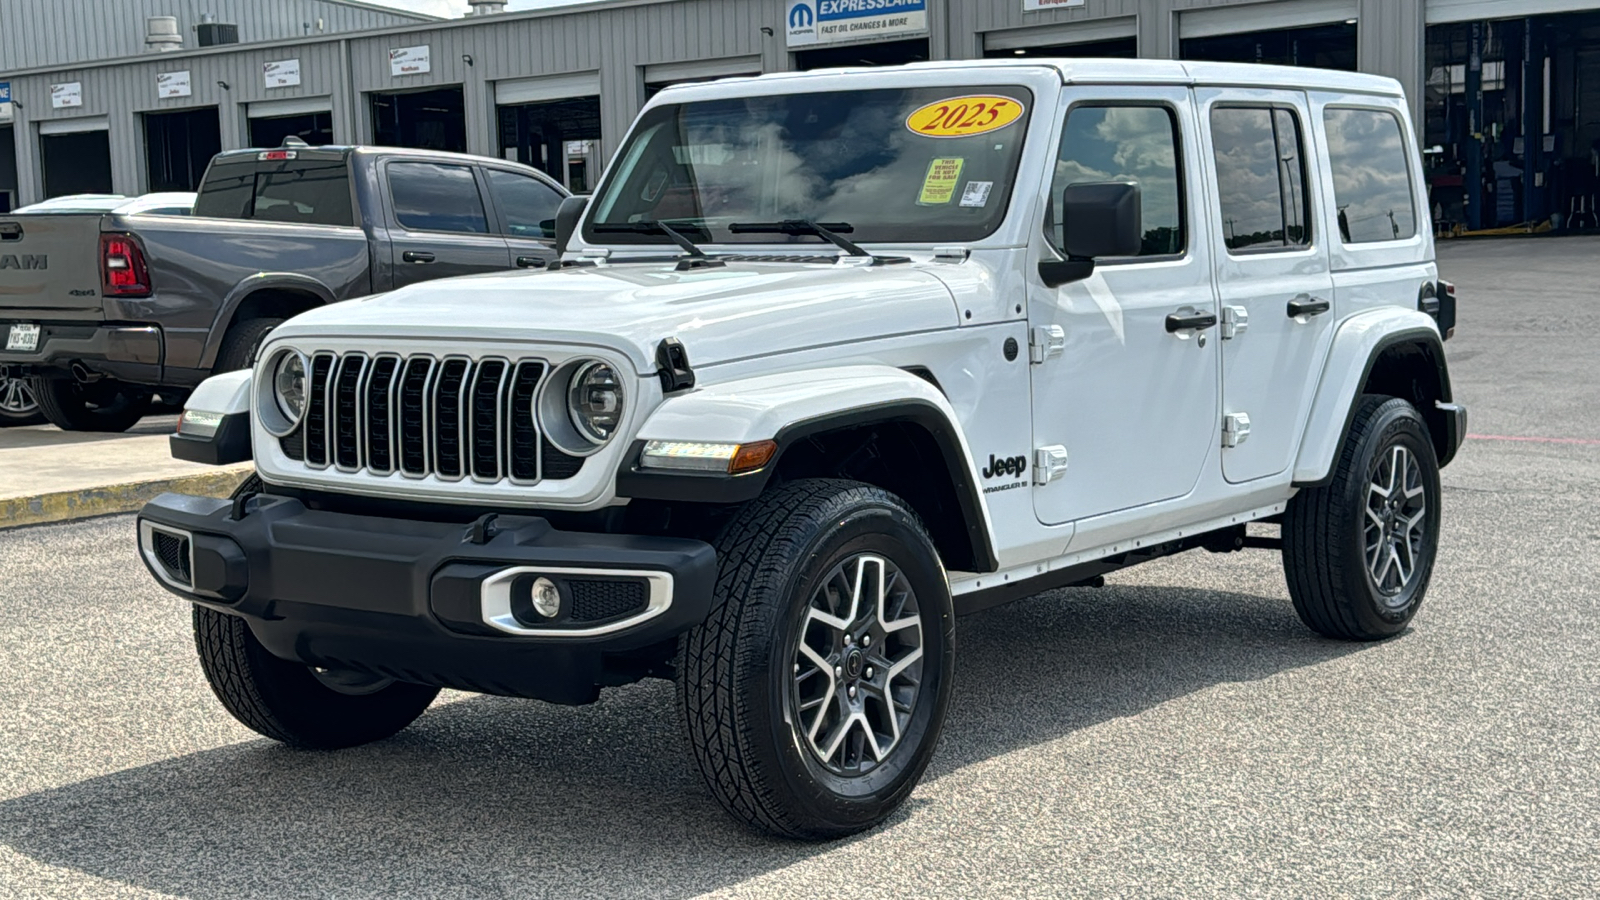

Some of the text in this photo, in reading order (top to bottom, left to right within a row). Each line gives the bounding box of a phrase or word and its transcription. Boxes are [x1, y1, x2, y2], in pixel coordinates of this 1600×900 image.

[821, 25, 838, 34] FAST
[838, 24, 849, 32] OIL
[849, 21, 881, 31] CHANGES
[888, 17, 909, 27] MORE
[921, 102, 1008, 130] 2025
[982, 454, 1026, 479] Jeep
[983, 482, 1020, 493] WRANGLER
